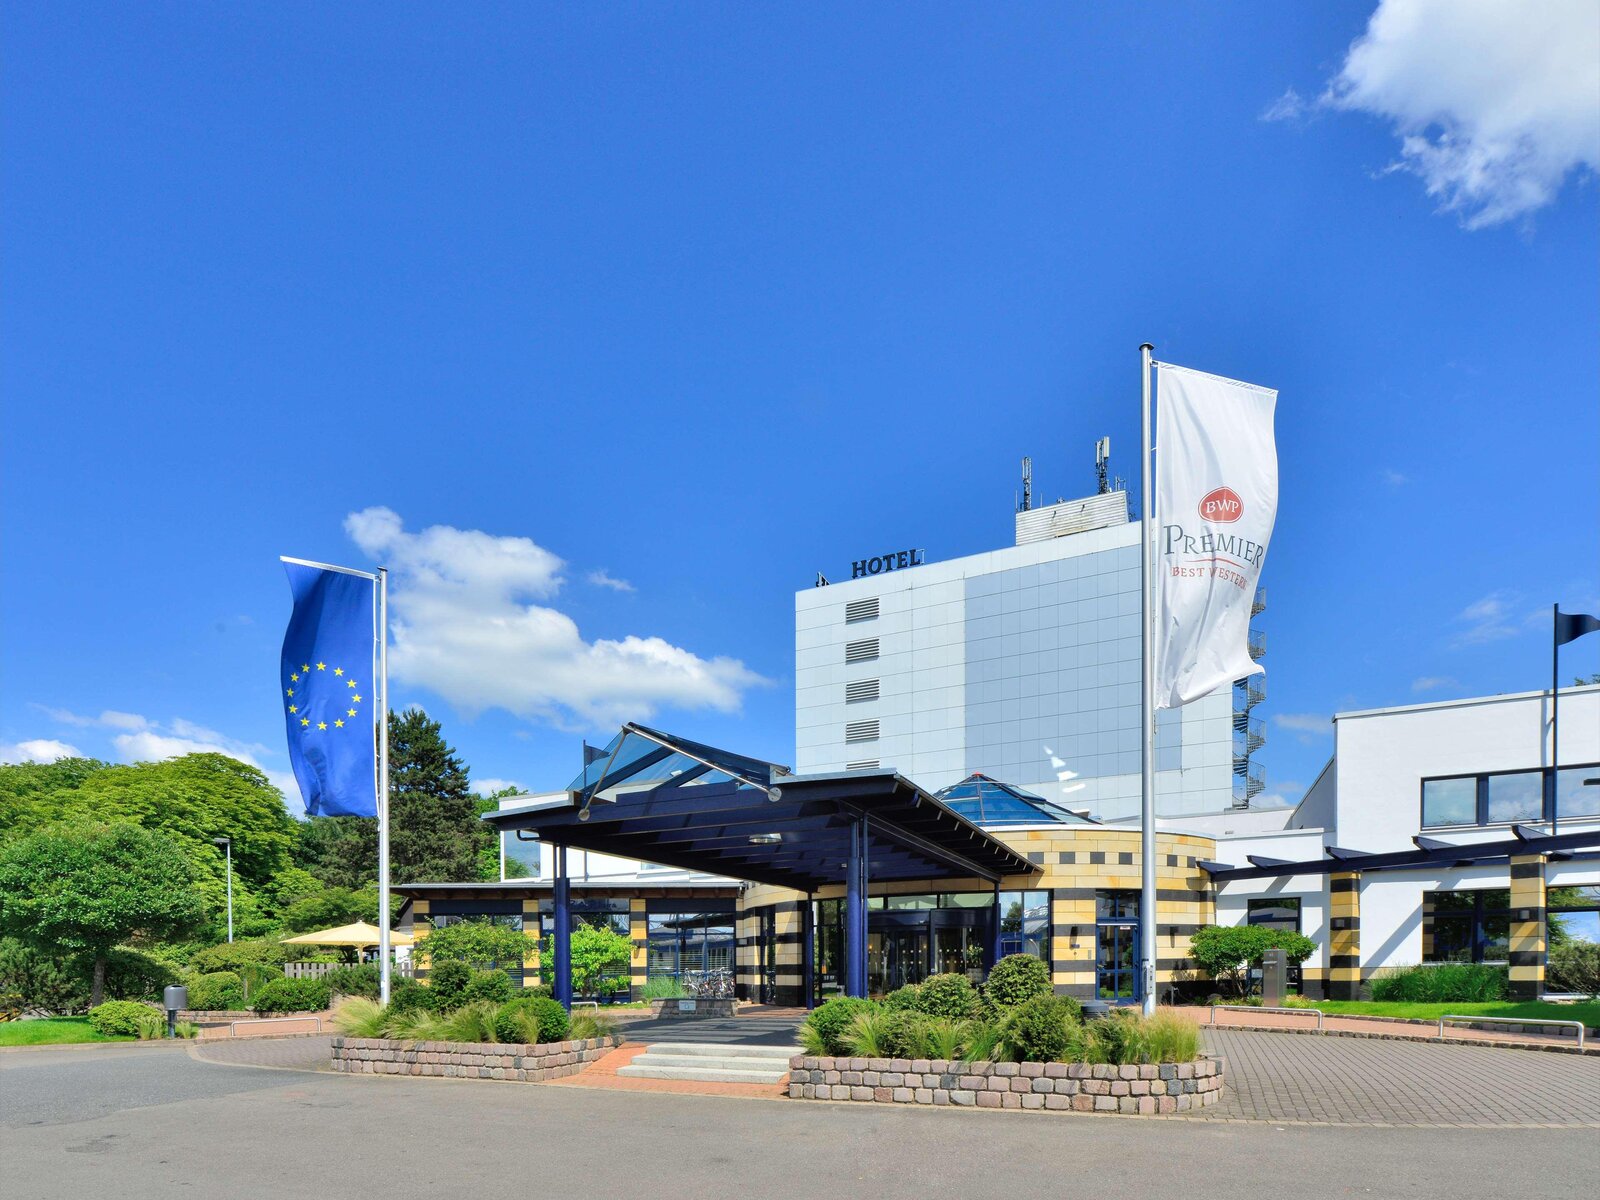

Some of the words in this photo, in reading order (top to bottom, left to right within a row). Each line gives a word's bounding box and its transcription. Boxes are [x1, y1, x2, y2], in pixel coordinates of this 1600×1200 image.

[1205, 499, 1239, 513] BWP
[1163, 524, 1264, 568] PREMIER
[851, 549, 921, 579] HOTEL
[1171, 566, 1205, 577] BEST
